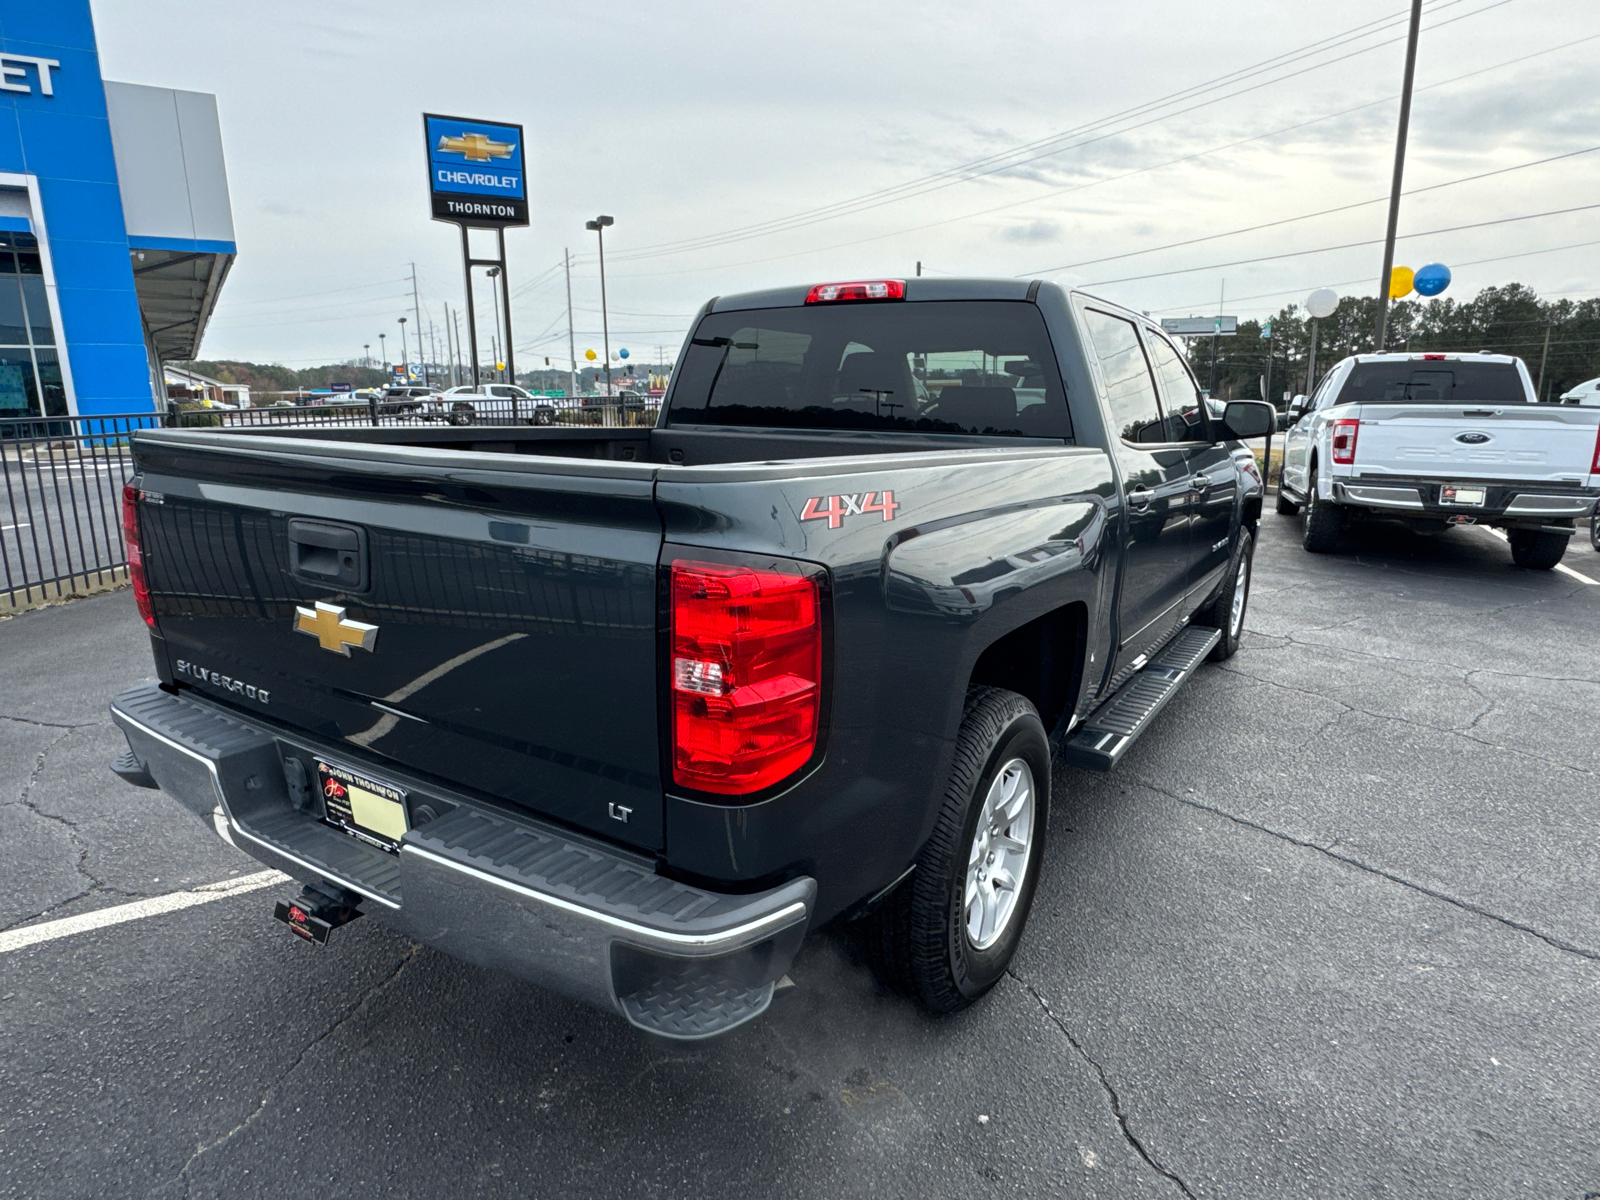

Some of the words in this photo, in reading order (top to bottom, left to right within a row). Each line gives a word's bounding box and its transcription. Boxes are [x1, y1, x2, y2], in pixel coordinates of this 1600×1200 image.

[438, 170, 518, 188] CHEVROLET
[447, 201, 515, 217] THORNTON
[176, 659, 271, 705] SILVERADO
[332, 768, 354, 783] JOHN
[608, 801, 634, 823] LT
